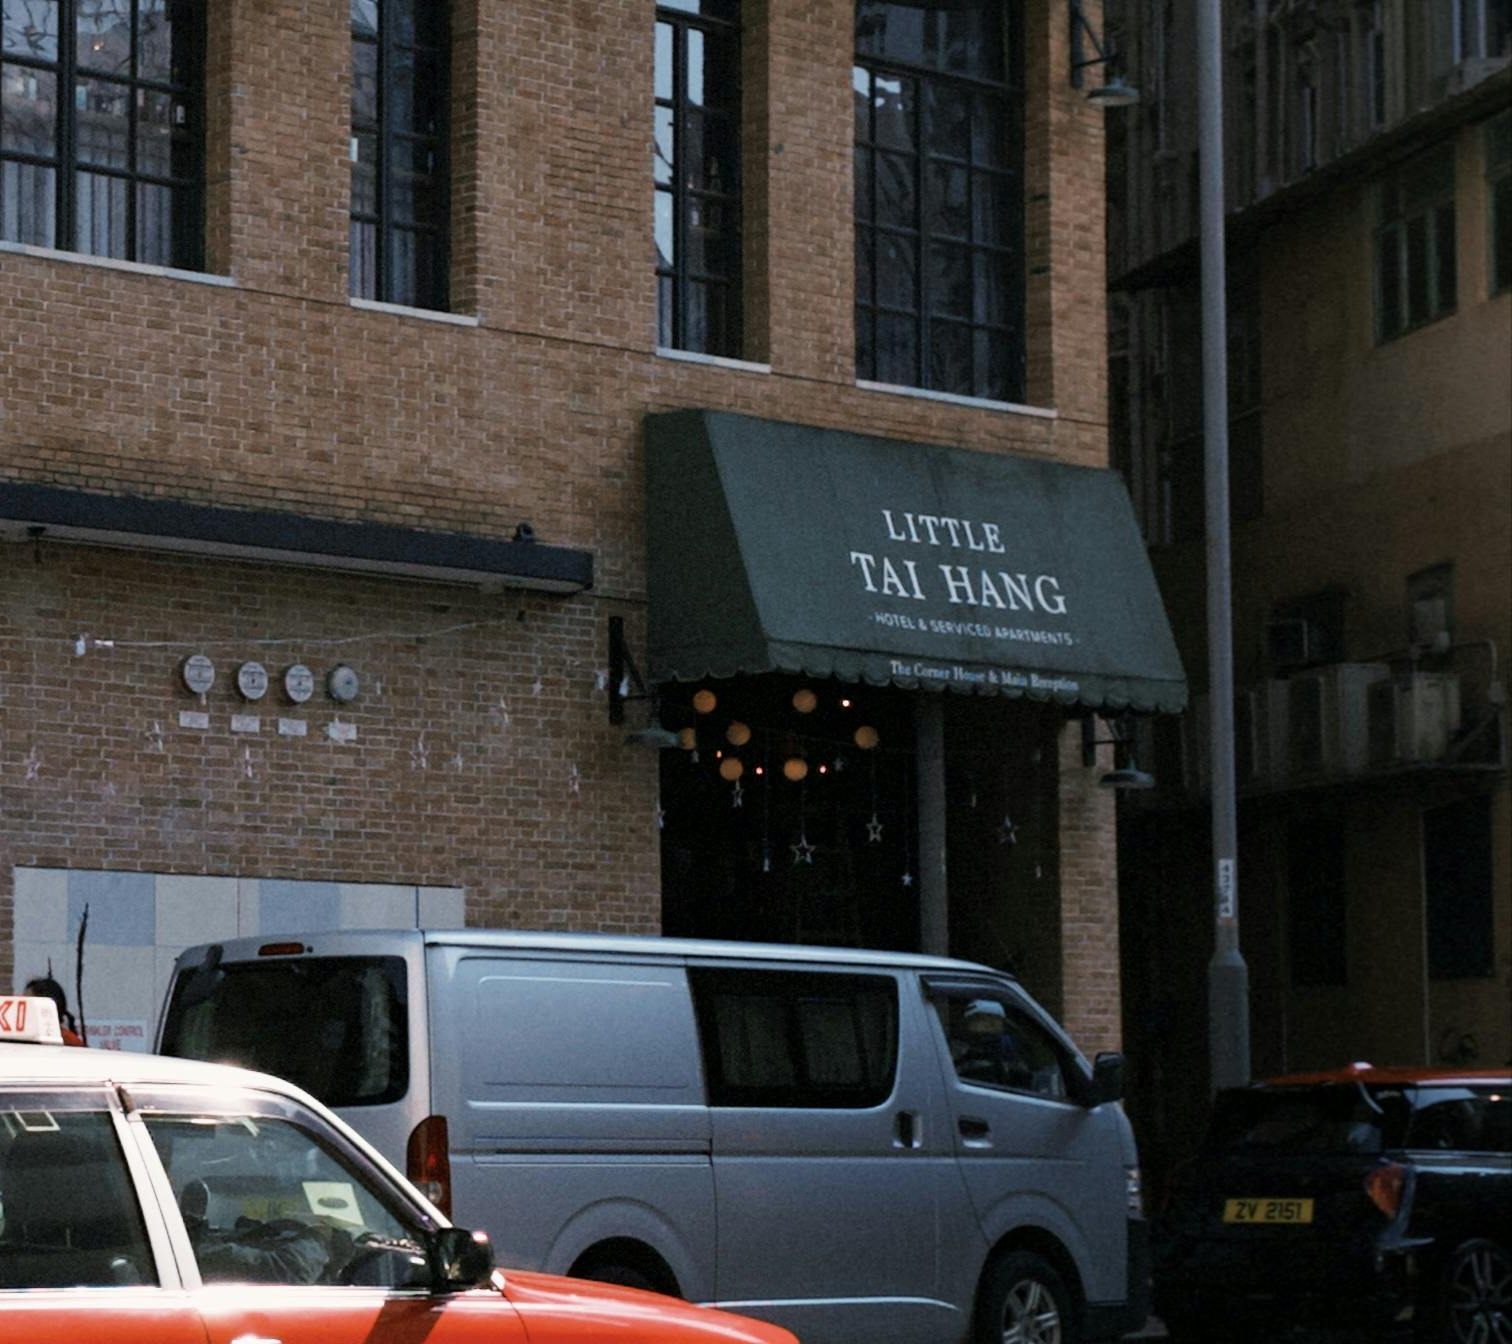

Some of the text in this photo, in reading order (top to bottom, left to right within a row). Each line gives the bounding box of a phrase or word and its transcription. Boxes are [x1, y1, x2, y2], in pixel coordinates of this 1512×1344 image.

[882, 509, 1006, 554] LITTLE
[850, 551, 1068, 615] TAI HANG
[875, 612, 1073, 646] HOTEL & SERVICED APARTMENTS
[890, 660, 911, 676] The
[913, 663, 950, 679] Corner
[1001, 671, 1028, 687] Main
[1030, 674, 1079, 692] Reception
[1265, 1201, 1302, 1221] 2151
